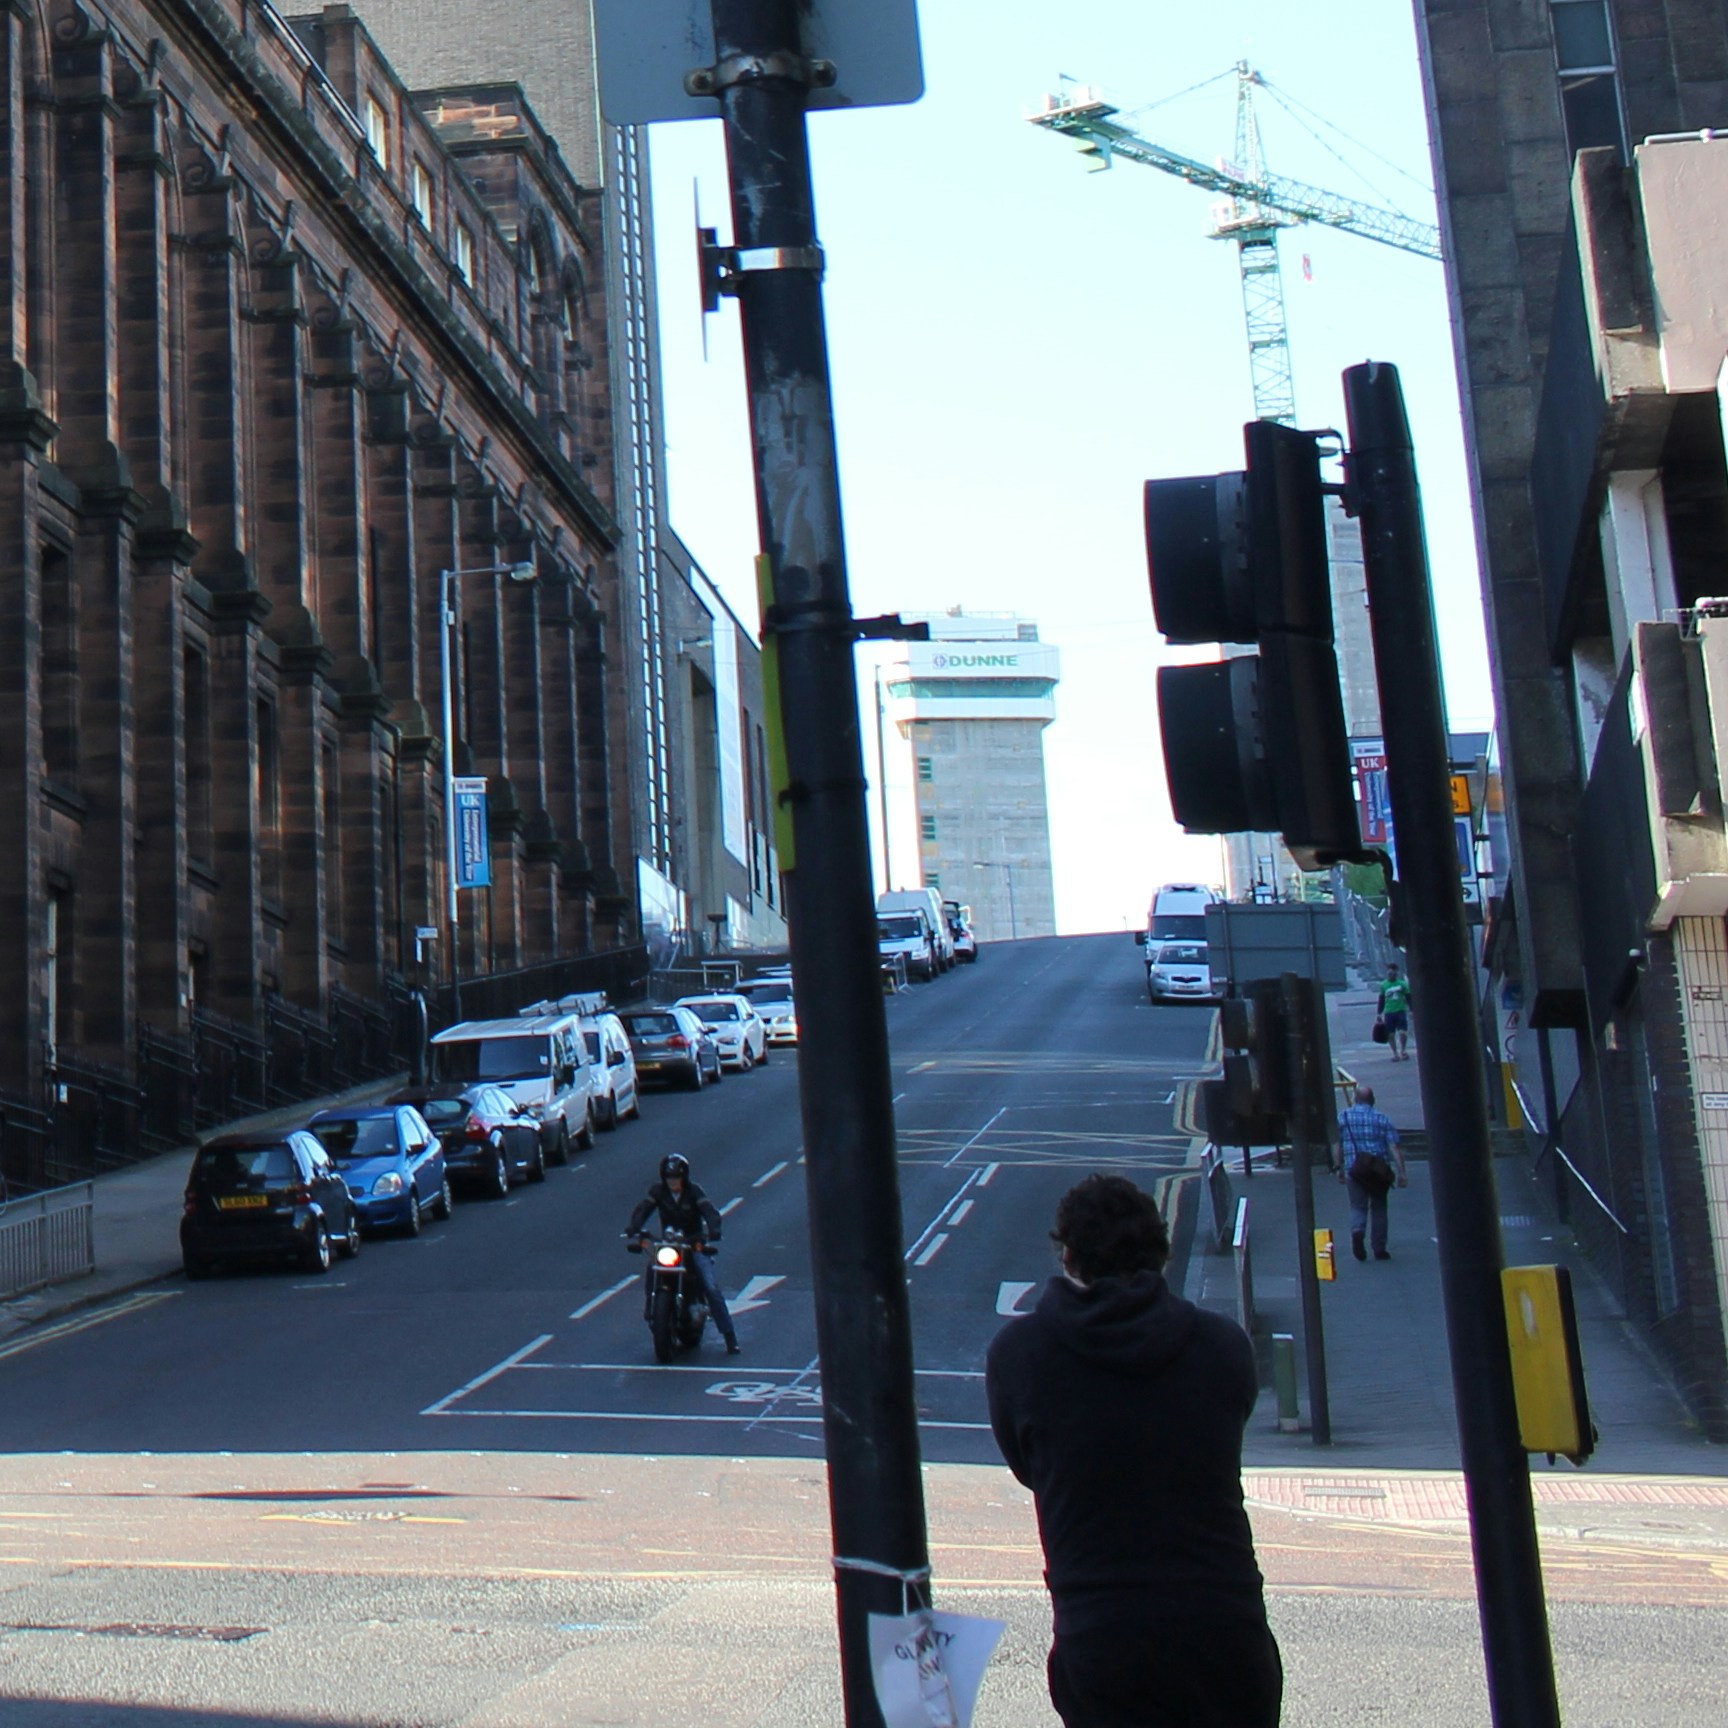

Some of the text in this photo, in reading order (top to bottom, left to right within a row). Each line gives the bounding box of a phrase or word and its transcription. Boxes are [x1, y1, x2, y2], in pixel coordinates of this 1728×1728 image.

[949, 655, 1018, 667] DUNNE
[1360, 758, 1380, 768] UK
[461, 794, 481, 806] UK
